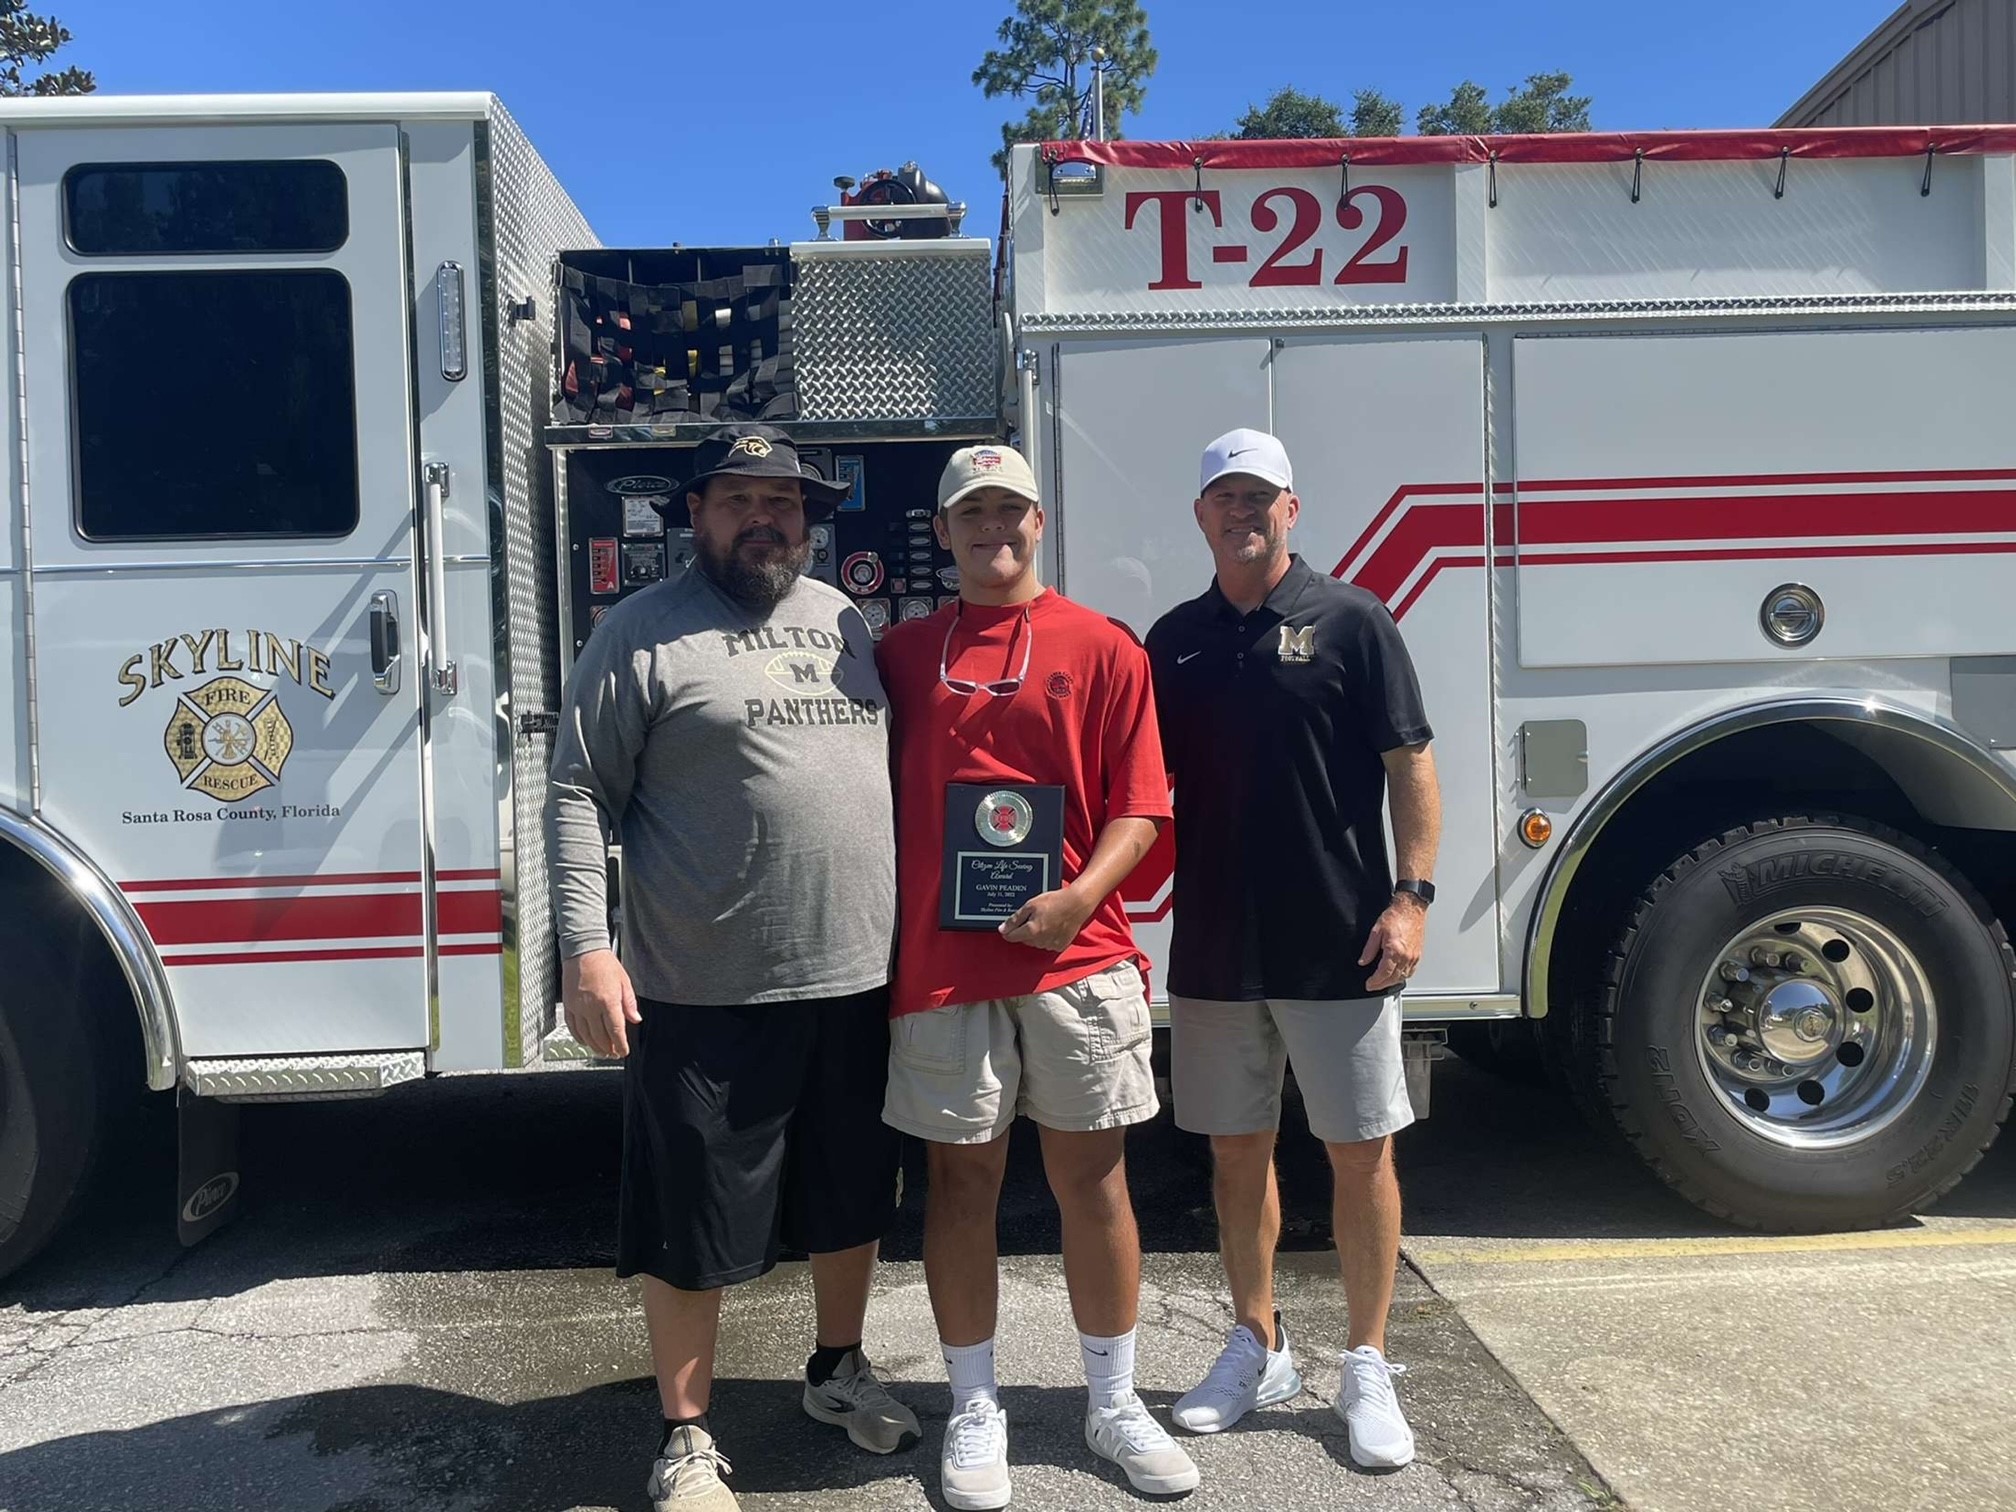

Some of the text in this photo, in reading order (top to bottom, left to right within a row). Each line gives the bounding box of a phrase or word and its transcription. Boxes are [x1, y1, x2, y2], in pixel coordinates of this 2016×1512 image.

[1124, 184, 1409, 291] T-22
[721, 626, 857, 660] MILTON
[1278, 625, 1316, 655] M
[118, 628, 336, 707] SKYLINE
[789, 663, 820, 683] M
[204, 688, 251, 707] FIRE
[744, 698, 879, 727] PANTHERS
[203, 774, 259, 791] RESCUE
[121, 804, 341, 825] Santa Rosa County, Florida
[975, 884, 1027, 892] GAVIN PEADEN
[1758, 853, 1948, 918] MICHELIN
